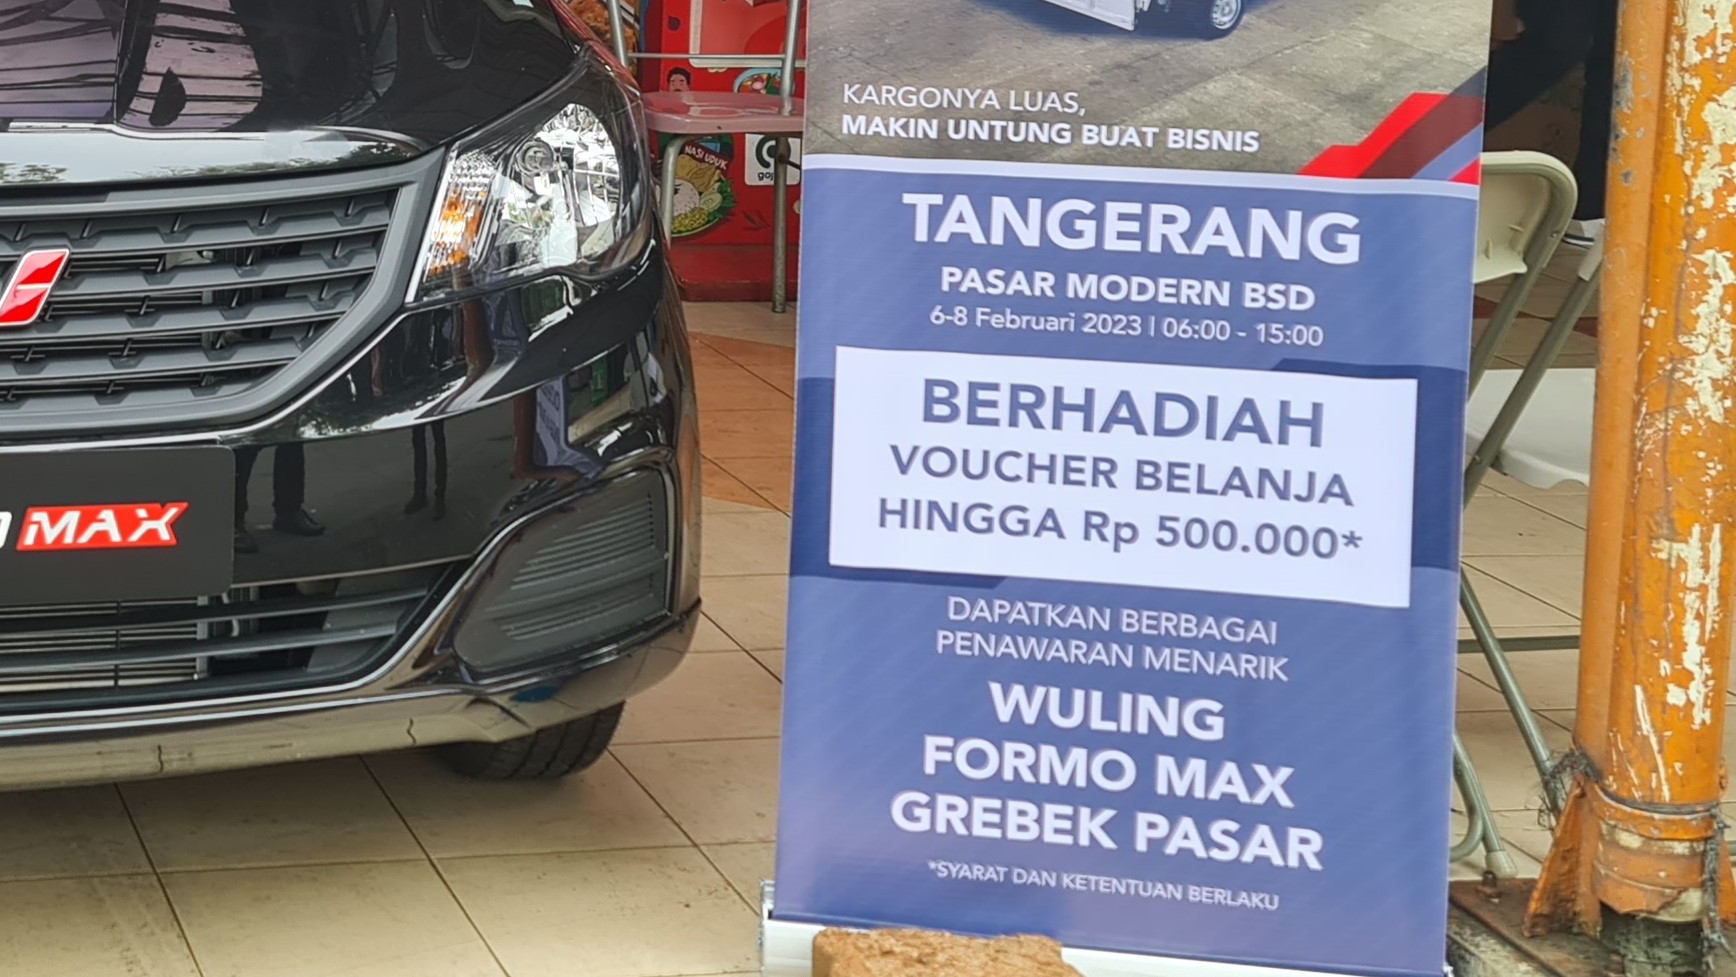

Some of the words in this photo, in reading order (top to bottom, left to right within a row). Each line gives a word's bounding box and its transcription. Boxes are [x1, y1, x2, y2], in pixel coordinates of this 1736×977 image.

[842, 83, 1001, 110] KARGONYA
[1009, 90, 1086, 116] LUAS,
[685, 144, 704, 159] NASI
[704, 153, 729, 170] UDUK
[842, 113, 940, 140] MAKIN
[948, 118, 1072, 144] UNTUNG
[1081, 124, 1160, 148] BUAT
[1168, 127, 1260, 153] BISNIS
[757, 172, 774, 181] goj
[901, 192, 1361, 265] TANGERANG
[941, 266, 1056, 298] PASAR
[1066, 273, 1231, 308] MODERN
[1243, 281, 1316, 312] BSD
[929, 305, 968, 327] 6-8
[975, 307, 1076, 333] Februari
[1081, 313, 1142, 337] 2023
[1162, 317, 1231, 342] 06:00
[1256, 324, 1324, 347] 15:00
[921, 377, 1324, 448] BERHADIAH
[890, 444, 1119, 489] VOUCHER
[1134, 459, 1355, 507] BELANJA
[22, 506, 180, 545] MAX
[878, 496, 1067, 540] HINGGA
[1082, 510, 1139, 553] Rp
[946, 595, 1112, 632] DAPATKAN
[1120, 608, 1278, 646] BERBAGAI
[935, 630, 1134, 669] PENAWARAN
[1143, 646, 1290, 682] MENARIK
[986, 681, 1225, 741] WULING
[922, 734, 1137, 792] FORMO
[1154, 753, 1296, 808] MAX
[889, 790, 1118, 850] GREBEK
[1134, 811, 1324, 871] PASAR
[1012, 867, 1057, 889] DAN
[1062, 873, 1183, 902] KETENTUAN
[1187, 885, 1280, 911] BERLAKU
